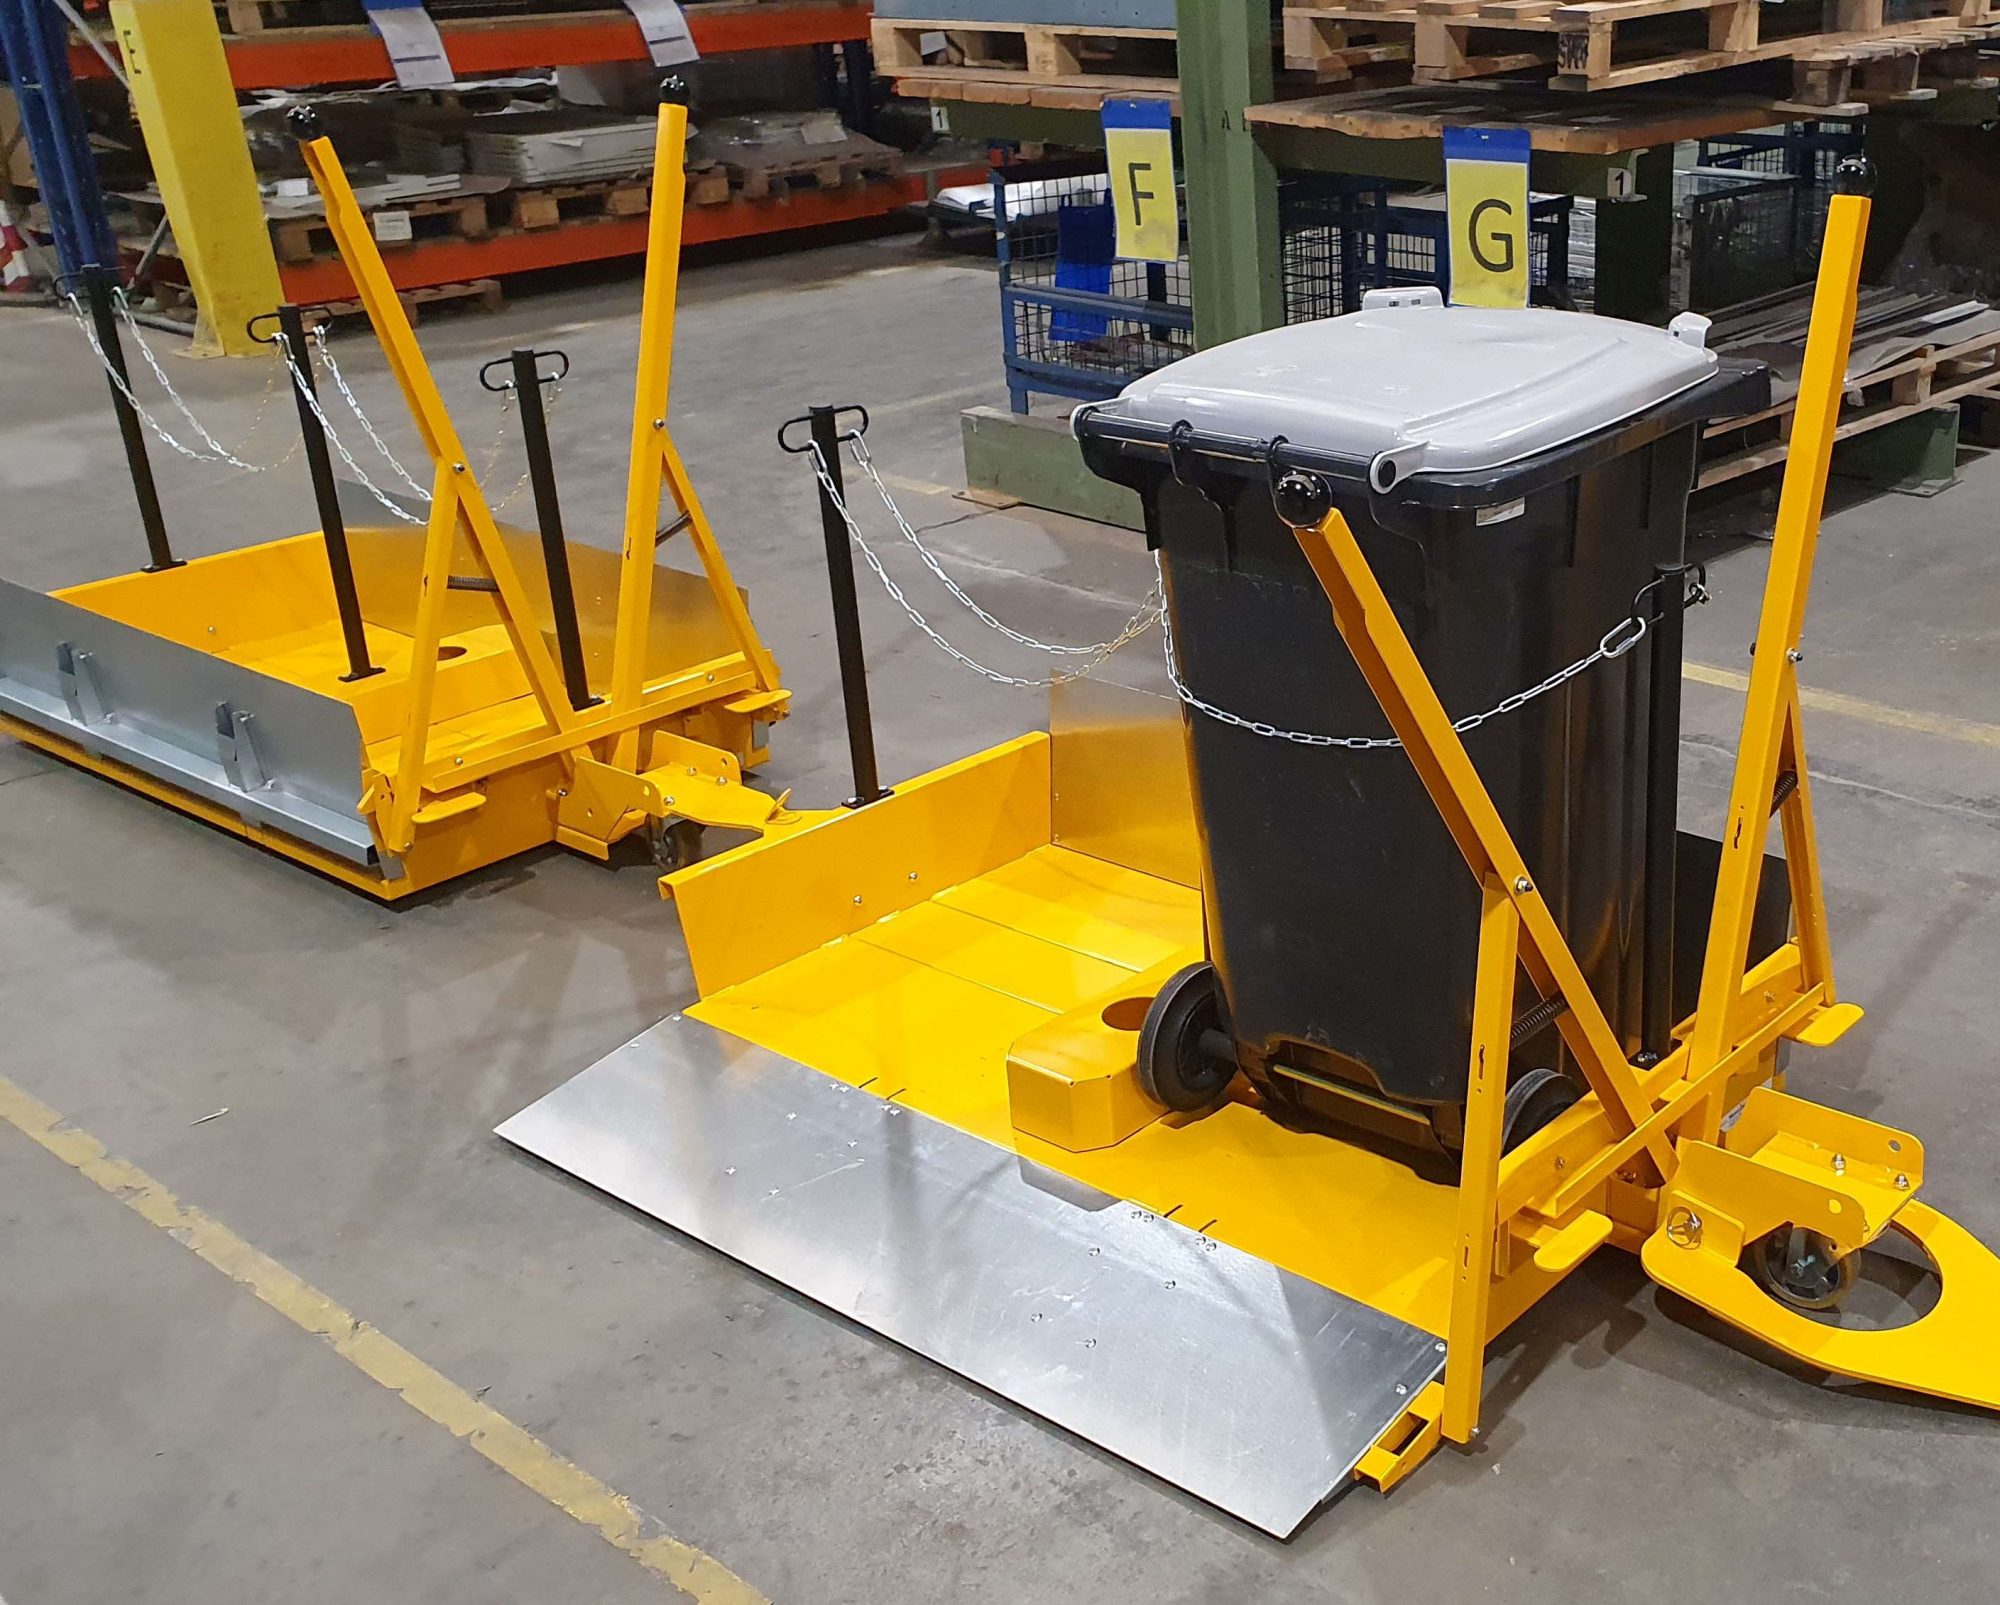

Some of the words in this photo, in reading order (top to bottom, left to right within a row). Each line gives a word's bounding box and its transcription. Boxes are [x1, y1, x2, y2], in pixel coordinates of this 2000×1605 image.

[936, 108, 943, 129] 1
[1128, 162, 1155, 226] F
[1615, 171, 1624, 196] 1
[1468, 198, 1514, 273] G
